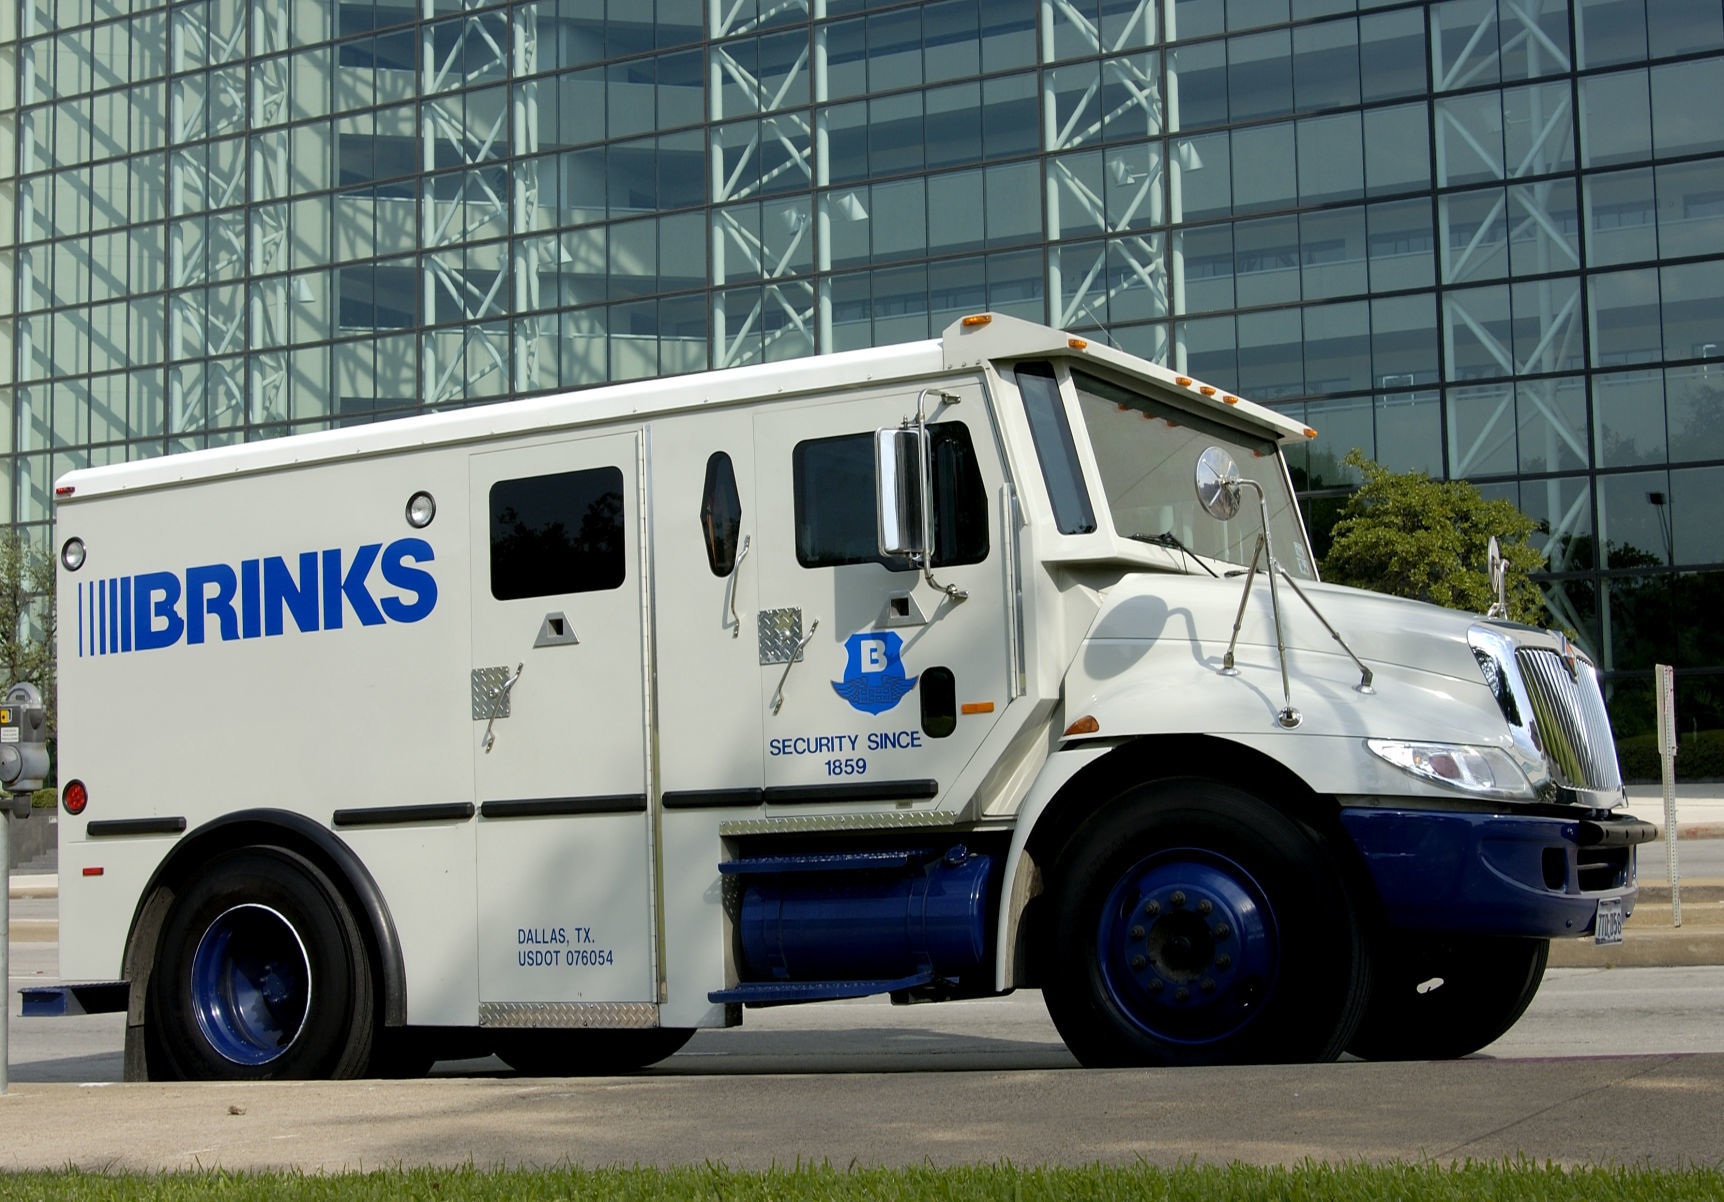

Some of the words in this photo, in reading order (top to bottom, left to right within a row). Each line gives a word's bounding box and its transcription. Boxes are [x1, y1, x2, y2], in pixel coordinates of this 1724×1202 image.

[134, 538, 438, 651] BRINKS
[860, 640, 888, 673] B
[770, 735, 859, 756] SECURITY
[867, 731, 922, 751] SINCE
[825, 758, 867, 776] 1859
[518, 928, 570, 947] DALLAS,
[575, 927, 595, 944] TX.
[518, 950, 561, 967] USDOT
[566, 950, 614, 966] 076054
